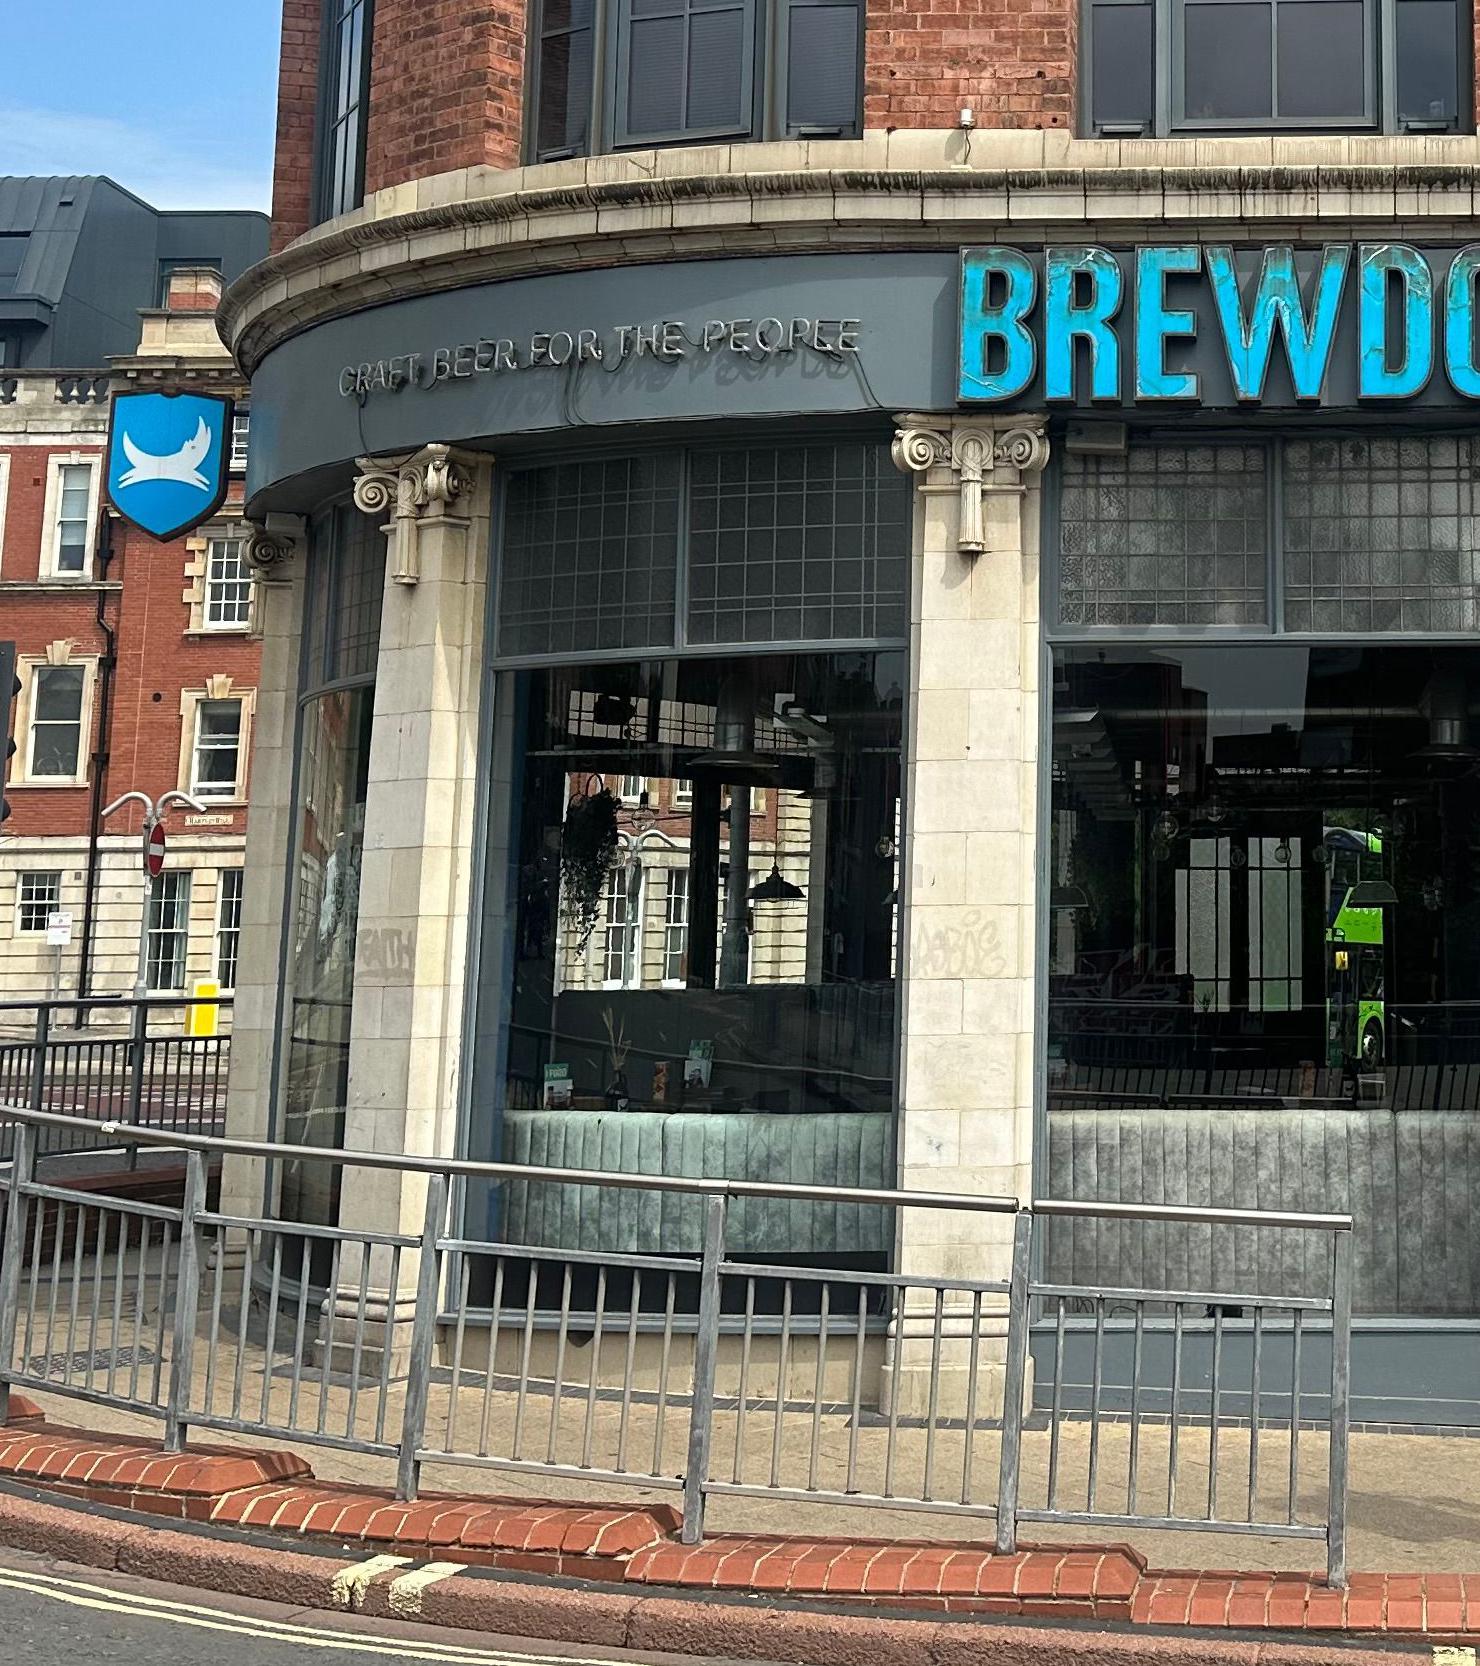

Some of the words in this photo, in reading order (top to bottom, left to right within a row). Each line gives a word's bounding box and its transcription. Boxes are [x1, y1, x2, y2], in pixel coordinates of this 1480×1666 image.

[338, 352, 421, 397] CRAFT
[432, 337, 518, 381] BEER
[530, 328, 602, 366] FOR
[613, 320, 685, 357] THE
[702, 317, 862, 352] PEOPLE
